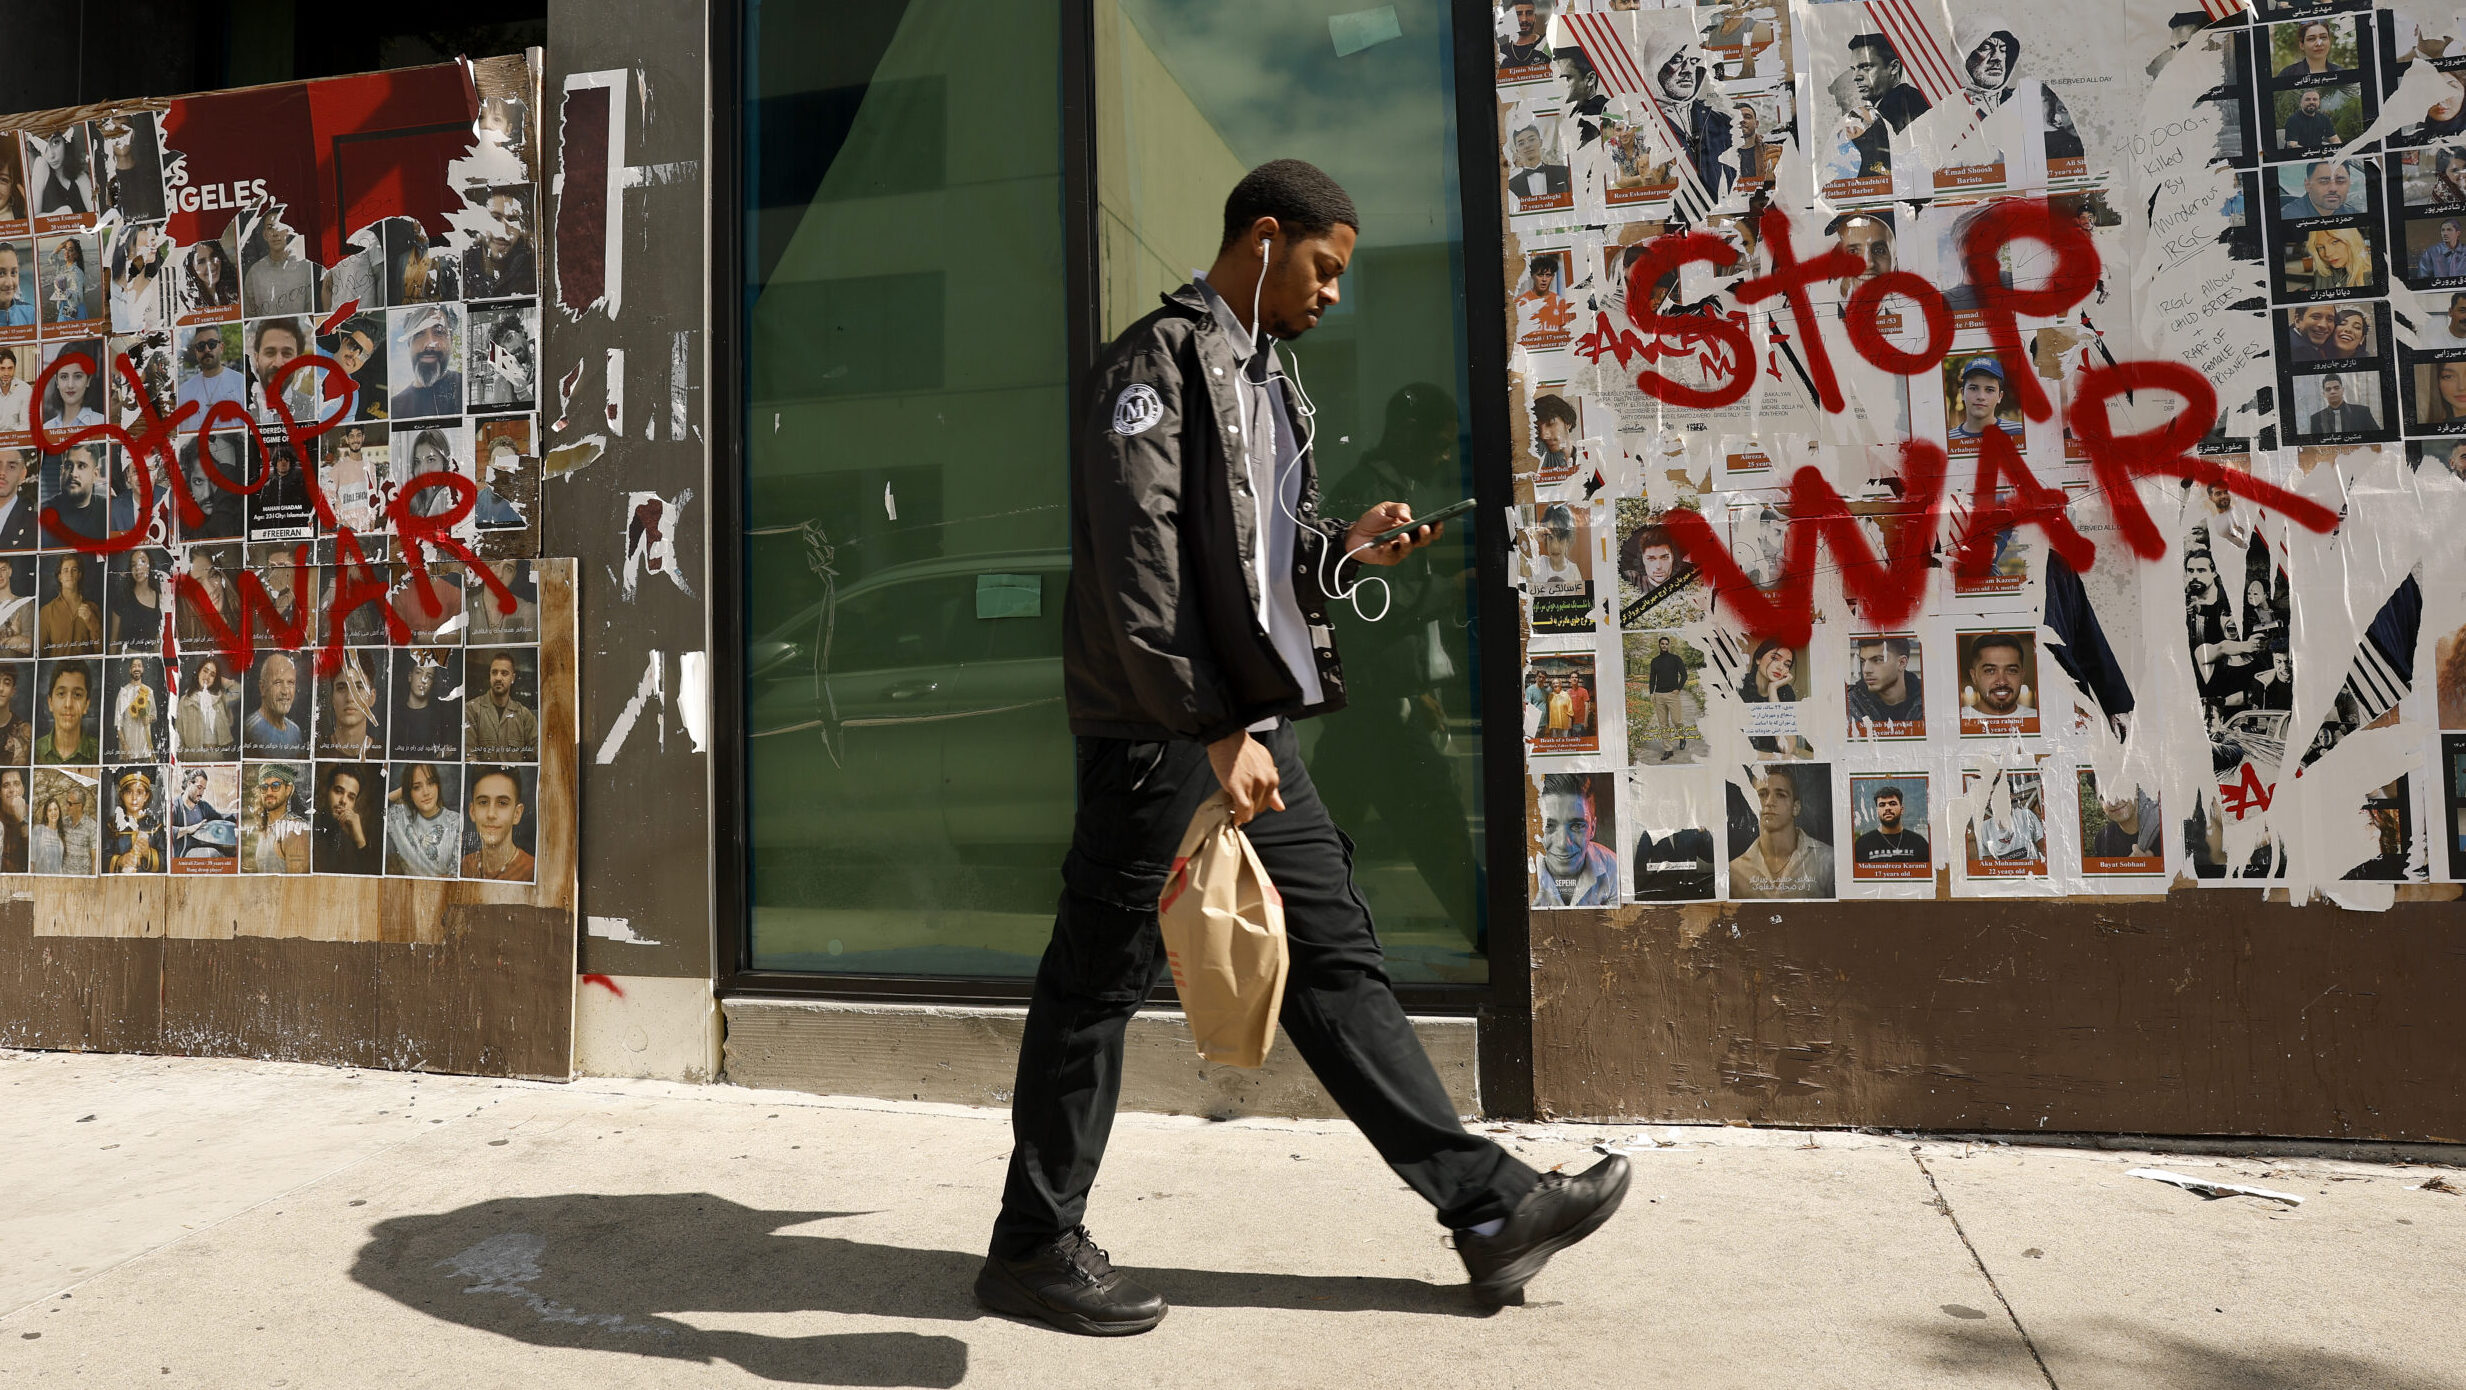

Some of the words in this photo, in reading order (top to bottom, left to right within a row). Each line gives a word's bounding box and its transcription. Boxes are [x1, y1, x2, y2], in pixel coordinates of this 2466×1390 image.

[262, 435, 281, 443] EGIME
[1665, 361, 2342, 648] WAR
[262, 529, 302, 538] #FREEIRAN
[174, 471, 517, 676] WAR
[2099, 861, 2119, 869] Bayat
[1554, 878, 1577, 887] SEPEHR
